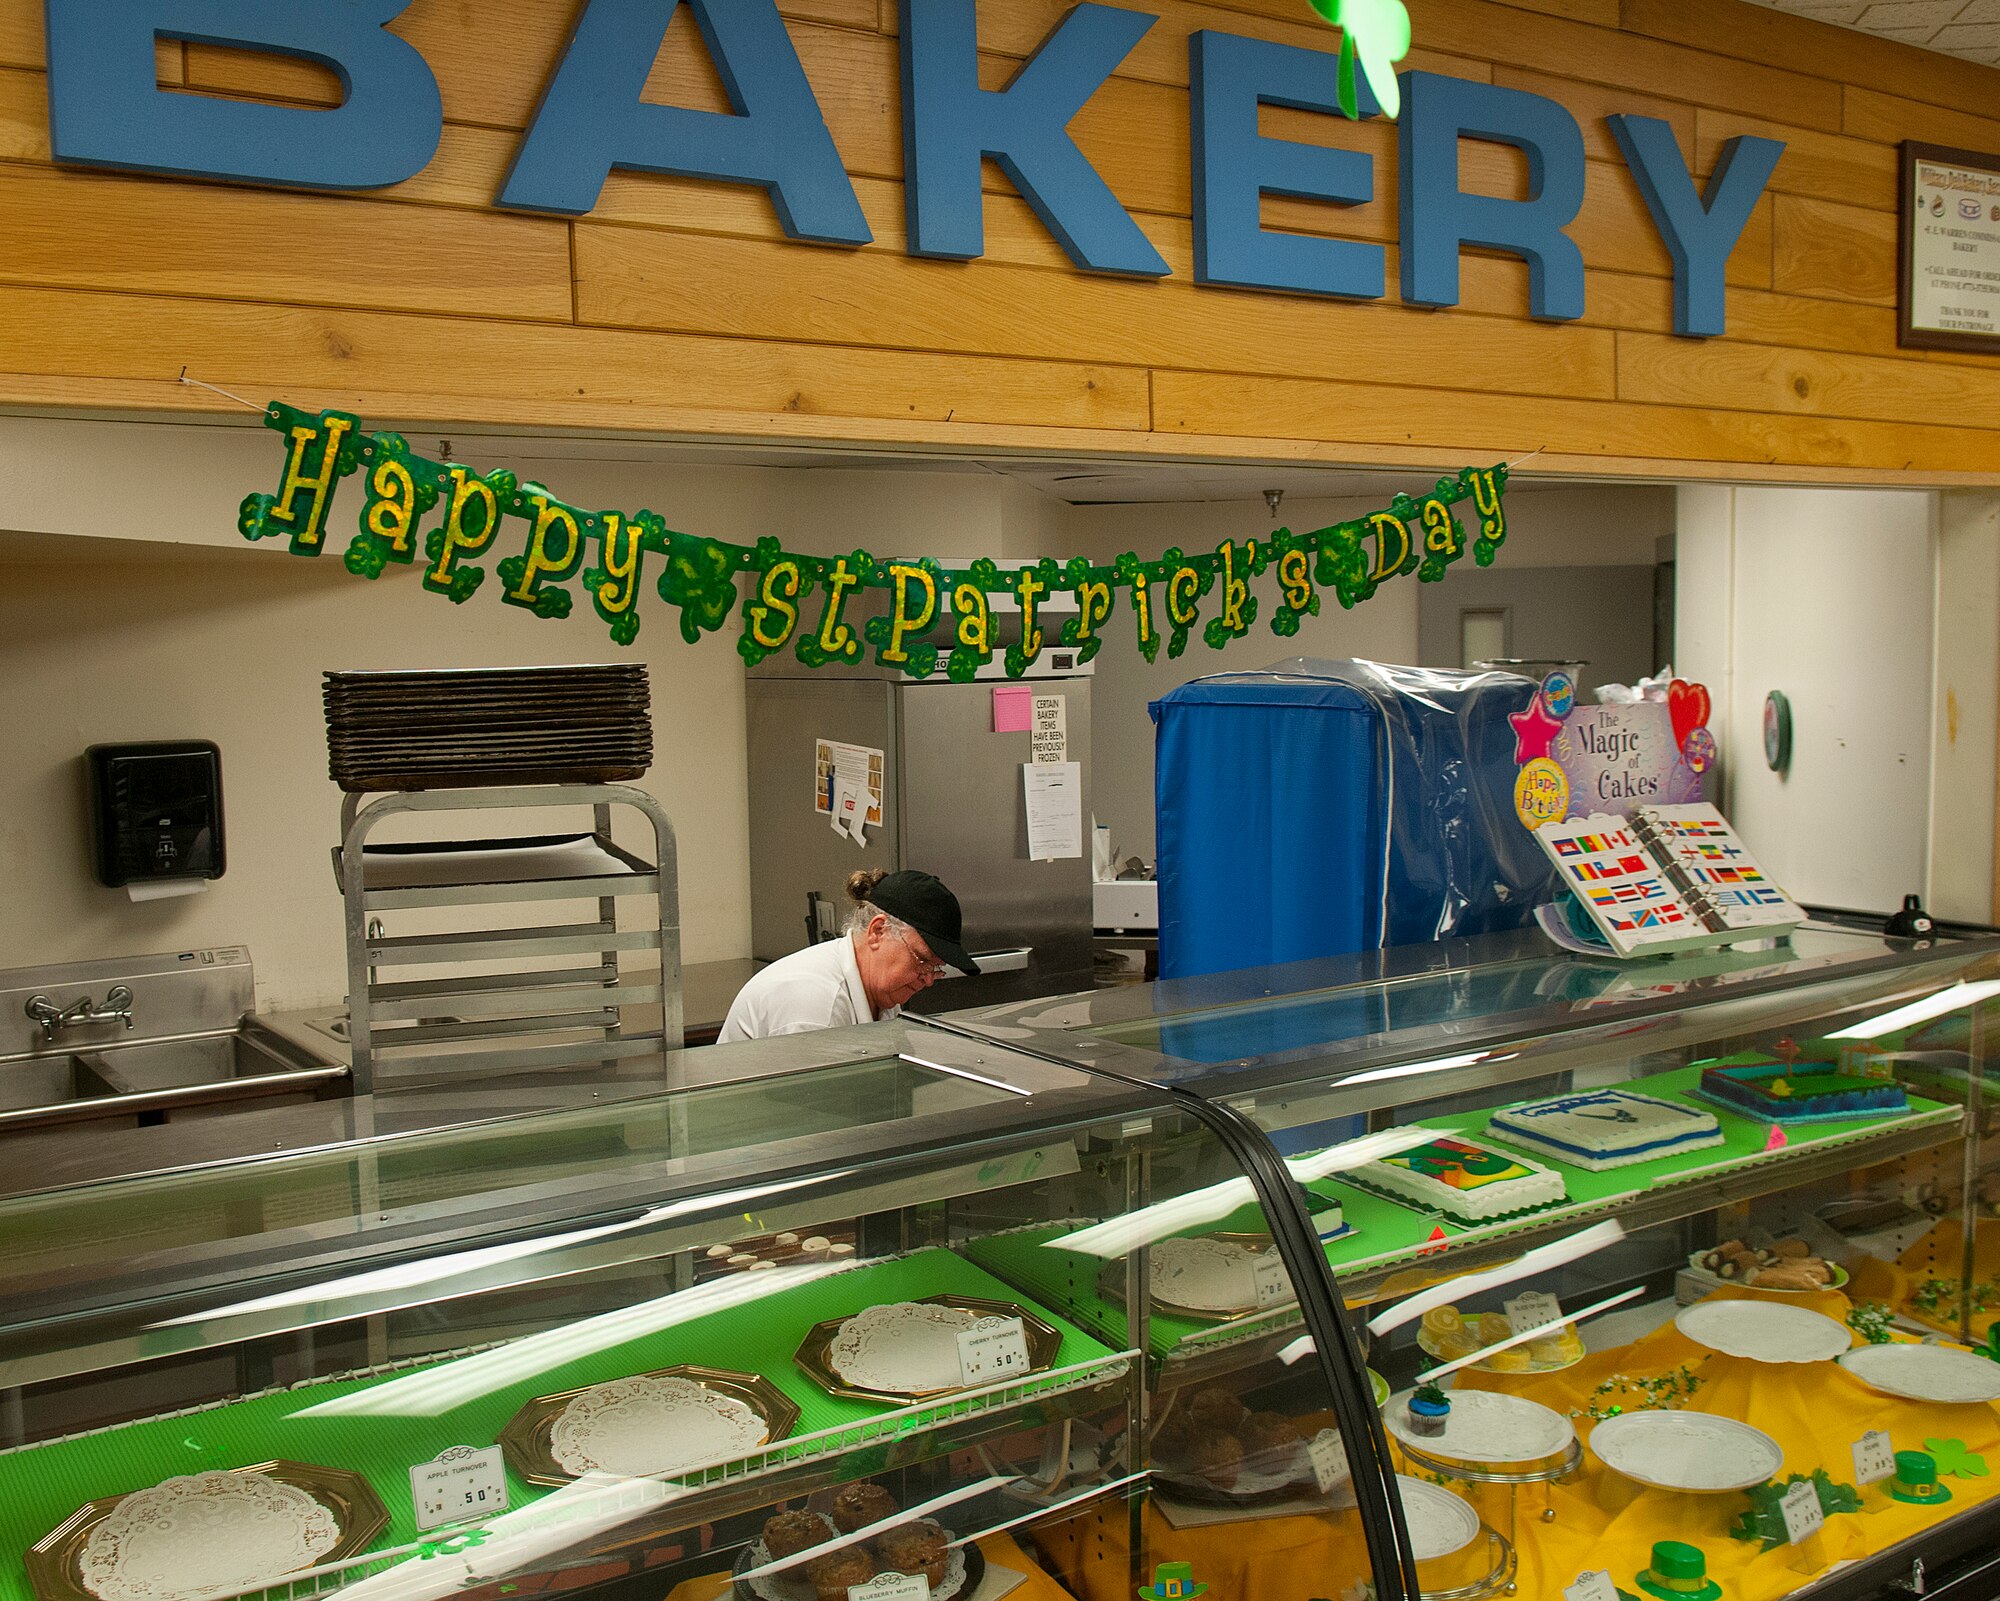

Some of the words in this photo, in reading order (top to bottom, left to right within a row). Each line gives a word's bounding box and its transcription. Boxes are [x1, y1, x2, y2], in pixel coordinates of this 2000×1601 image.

[48, 0, 1785, 338] BAKERY
[271, 417, 644, 613] Happy
[750, 559, 857, 656] St.
[882, 540, 1311, 662] Patrick's
[1369, 469, 1503, 583] Day
[1036, 699, 1059, 709] CERTAIN
[1037, 710, 1059, 720] BAKERY
[1598, 711, 1620, 729] The
[1040, 721, 1056, 730] ITEMS
[1033, 731, 1048, 741] HAVE
[1049, 731, 1064, 741] BEEN
[1576, 723, 1640, 762] Magic
[1032, 741, 1065, 752] PREVIOUSLY
[1037, 752, 1061, 763] FROZEN
[1628, 753, 1642, 769] of
[969, 1337, 990, 1346] CHERRY
[992, 1330, 1018, 1341] TURNOVER
[427, 1471, 449, 1480] APPLE
[452, 1461, 488, 1475] TURNOVER
[858, 1590, 893, 1601] BLUEBERRY
[896, 1586, 918, 1594] MUFFIN
